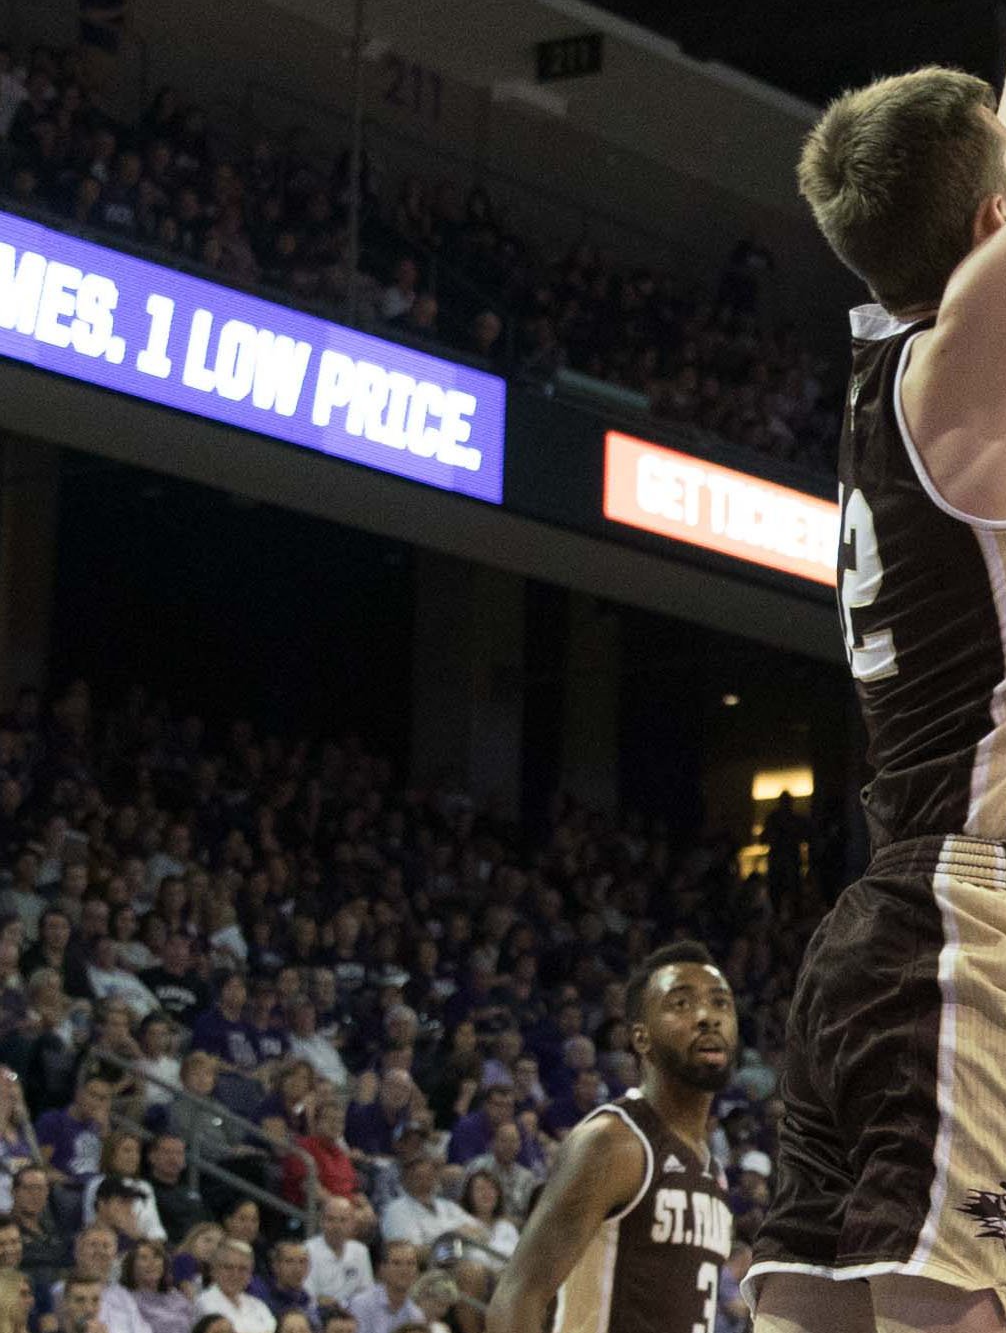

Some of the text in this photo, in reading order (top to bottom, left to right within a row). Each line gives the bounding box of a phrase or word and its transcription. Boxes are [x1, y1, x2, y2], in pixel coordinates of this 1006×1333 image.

[136, 293, 175, 378] 1
[182, 309, 312, 417] LOW
[311, 349, 482, 471] PRICE.
